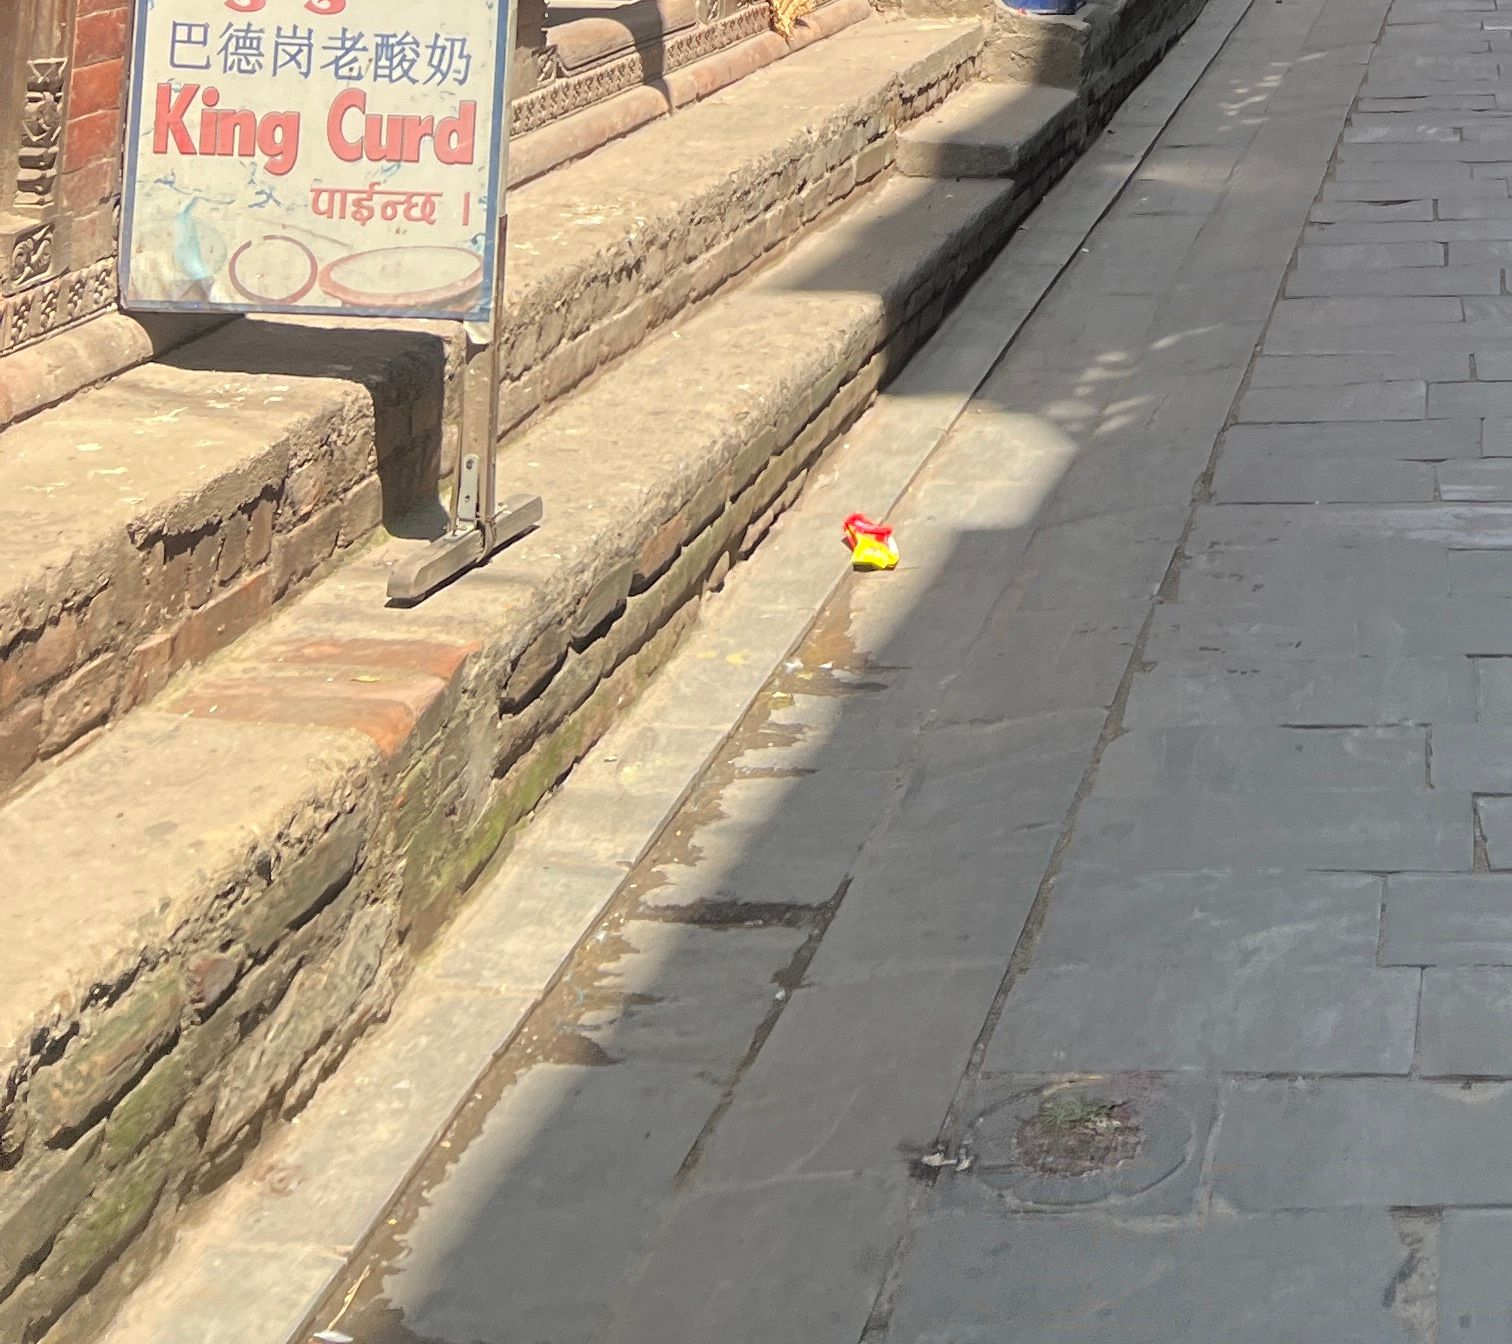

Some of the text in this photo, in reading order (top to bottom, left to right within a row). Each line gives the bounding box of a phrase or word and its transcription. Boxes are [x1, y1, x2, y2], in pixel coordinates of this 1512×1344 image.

[169, 19, 473, 88] 巴德岗老酸奶
[152, 82, 478, 175] King Curd
